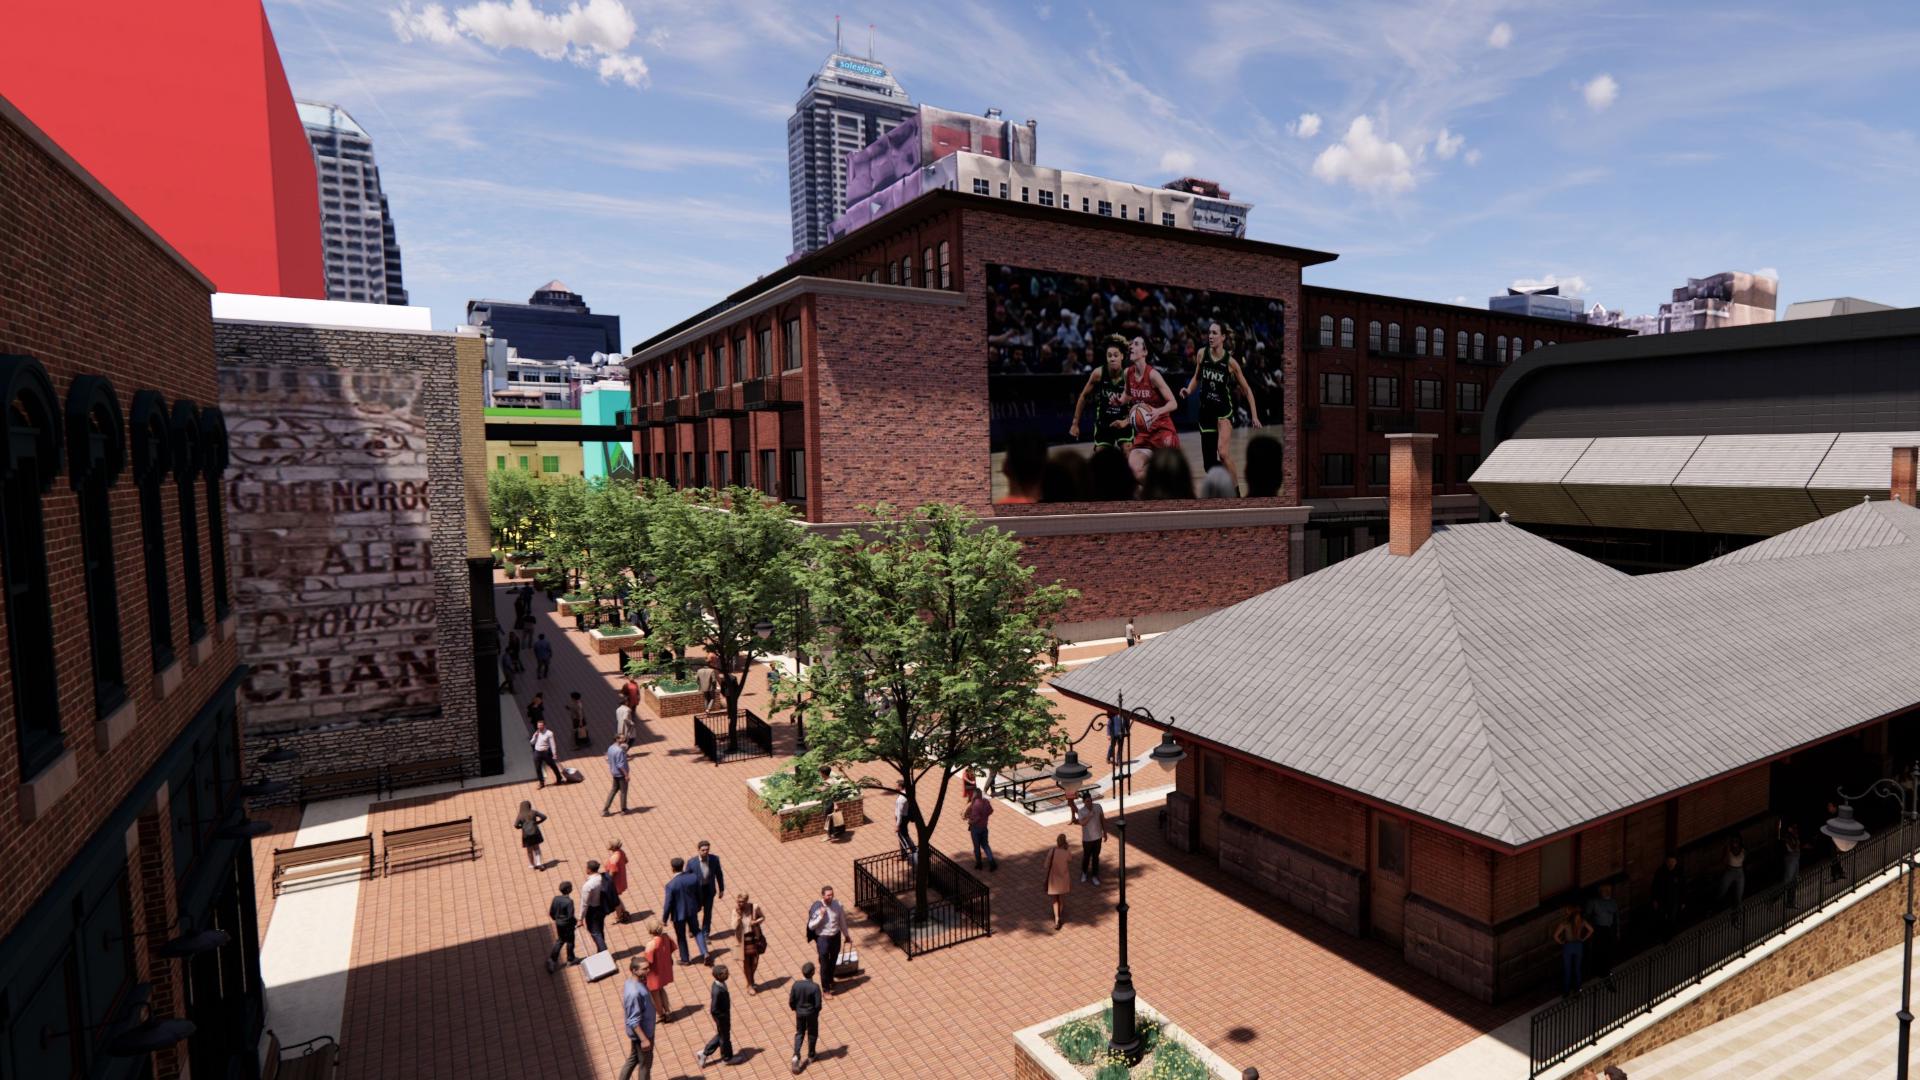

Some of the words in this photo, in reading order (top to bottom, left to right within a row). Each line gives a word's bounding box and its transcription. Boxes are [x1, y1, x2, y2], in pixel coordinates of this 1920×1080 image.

[840, 61, 883, 76] salesforce
[1202, 367, 1225, 383] LYNX
[1130, 387, 1151, 398] FEVER
[241, 649, 437, 702] CHAN
